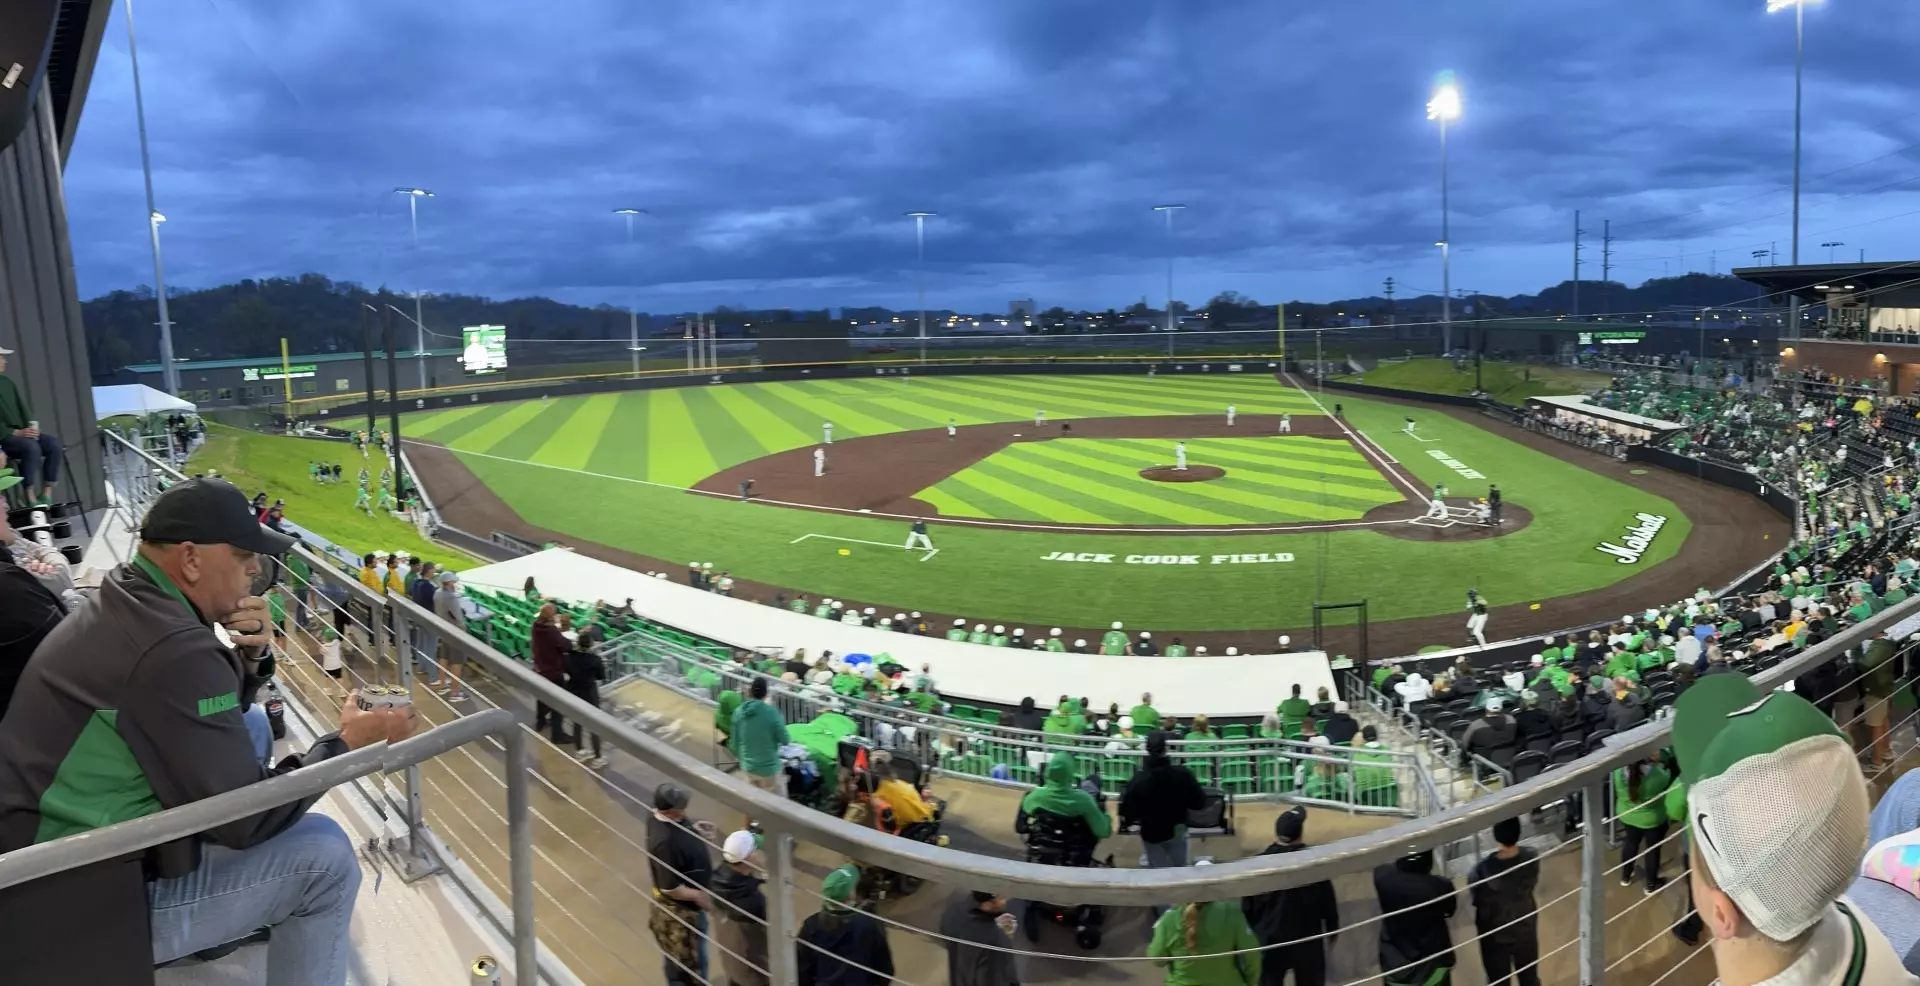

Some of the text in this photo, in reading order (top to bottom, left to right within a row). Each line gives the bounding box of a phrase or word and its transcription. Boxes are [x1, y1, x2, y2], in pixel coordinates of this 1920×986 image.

[1594, 511, 1668, 565] Marshall
[1039, 551, 1296, 565] JACK COOK FIELD
